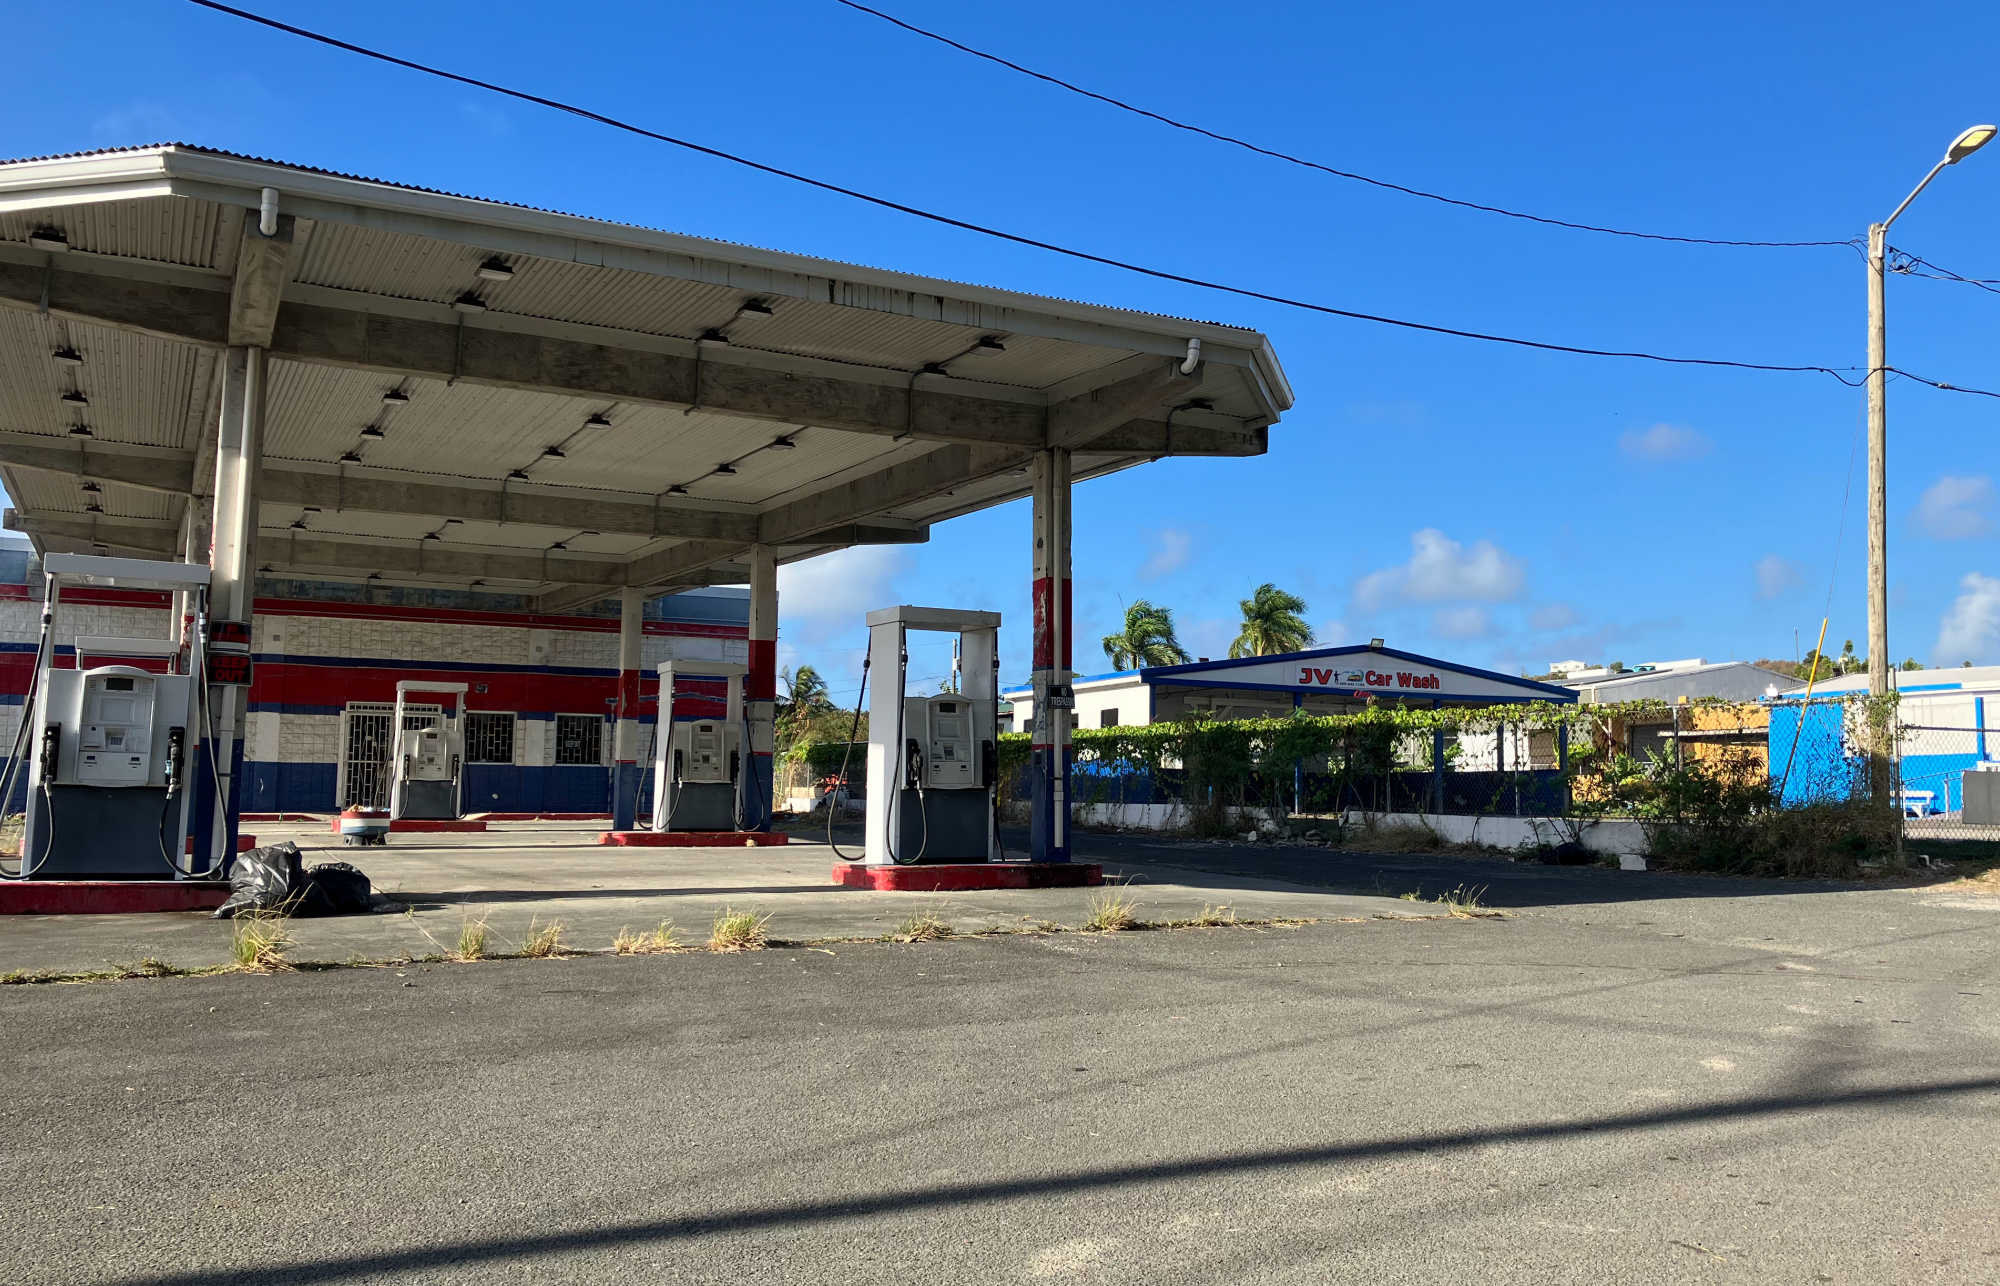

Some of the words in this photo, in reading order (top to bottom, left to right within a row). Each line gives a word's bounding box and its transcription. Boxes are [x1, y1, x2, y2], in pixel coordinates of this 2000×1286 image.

[215, 669, 245, 681] OUT
[1299, 667, 1333, 685] JV
[1365, 669, 1393, 687] Car
[1396, 671, 1440, 690] Wash
